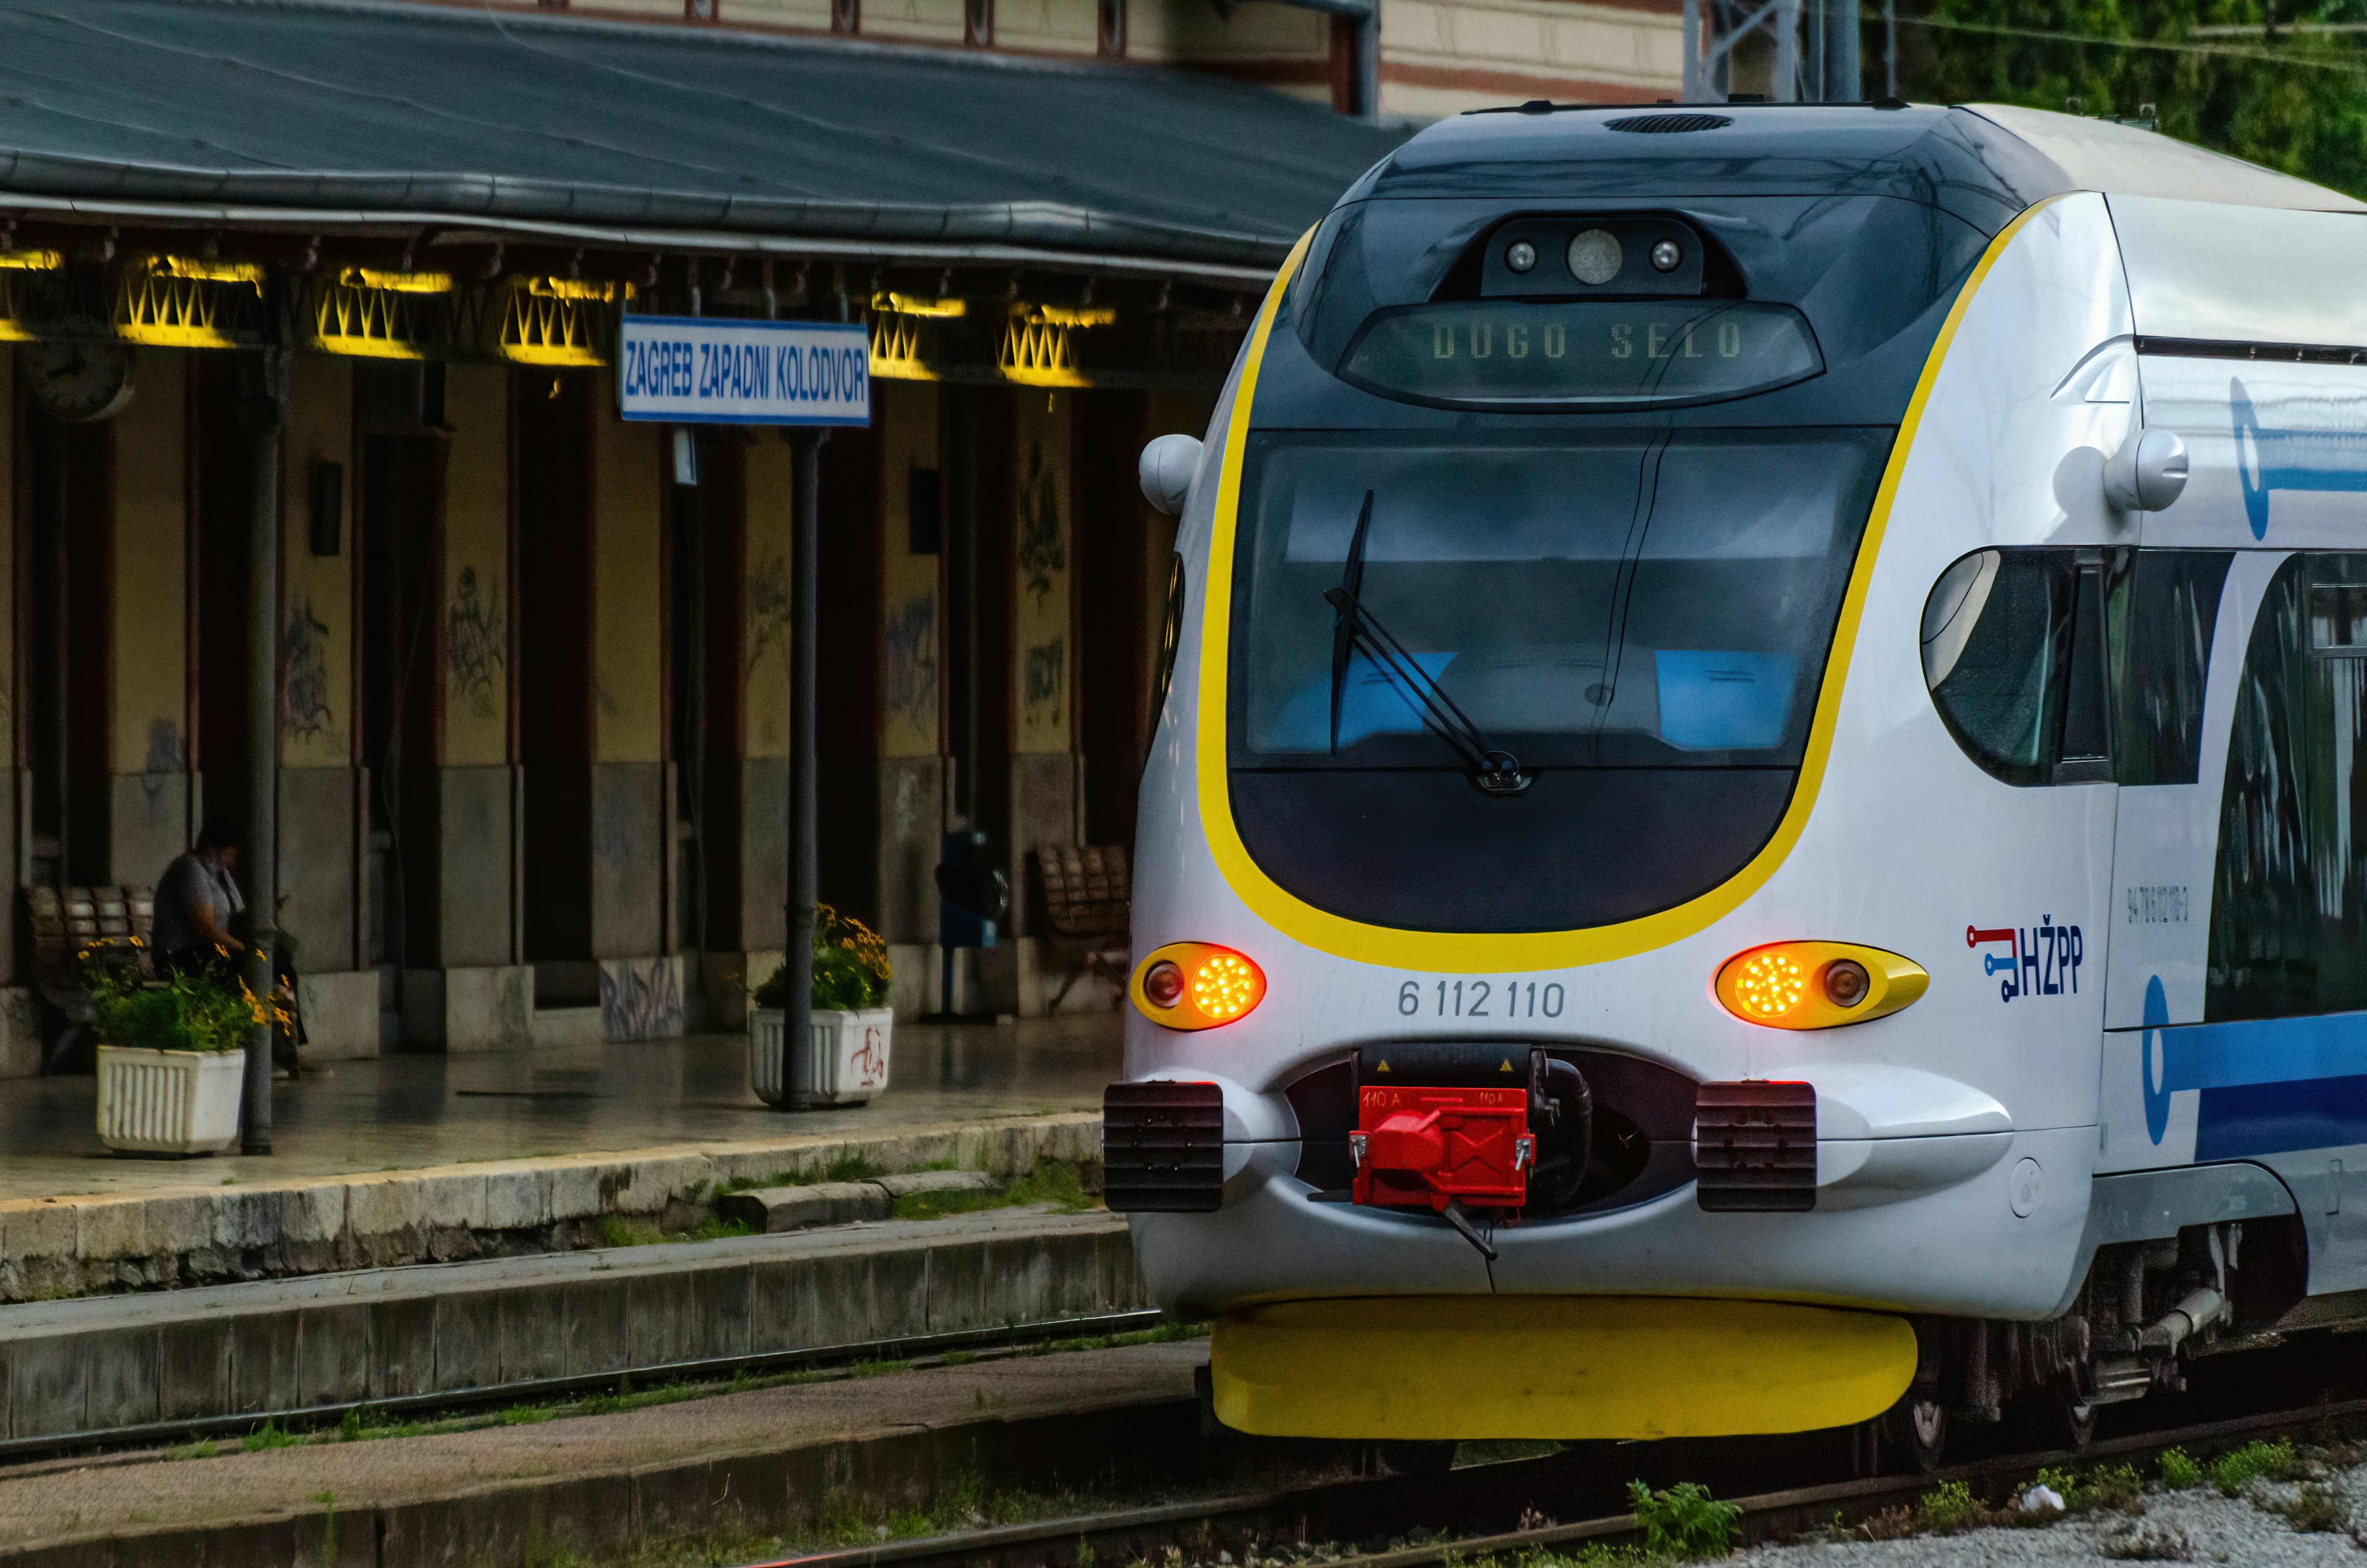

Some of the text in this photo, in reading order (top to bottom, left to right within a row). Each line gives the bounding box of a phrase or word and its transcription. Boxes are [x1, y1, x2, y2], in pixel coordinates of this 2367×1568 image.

[1433, 322, 1740, 359] DUGO SELO
[626, 341, 865, 403] ZAGREB ZAPADNI KOLODVOR
[2019, 914, 2083, 996] HŽPP
[1398, 980, 1564, 1017] 6 112 110
[1363, 1091, 1400, 1106] 110 A
